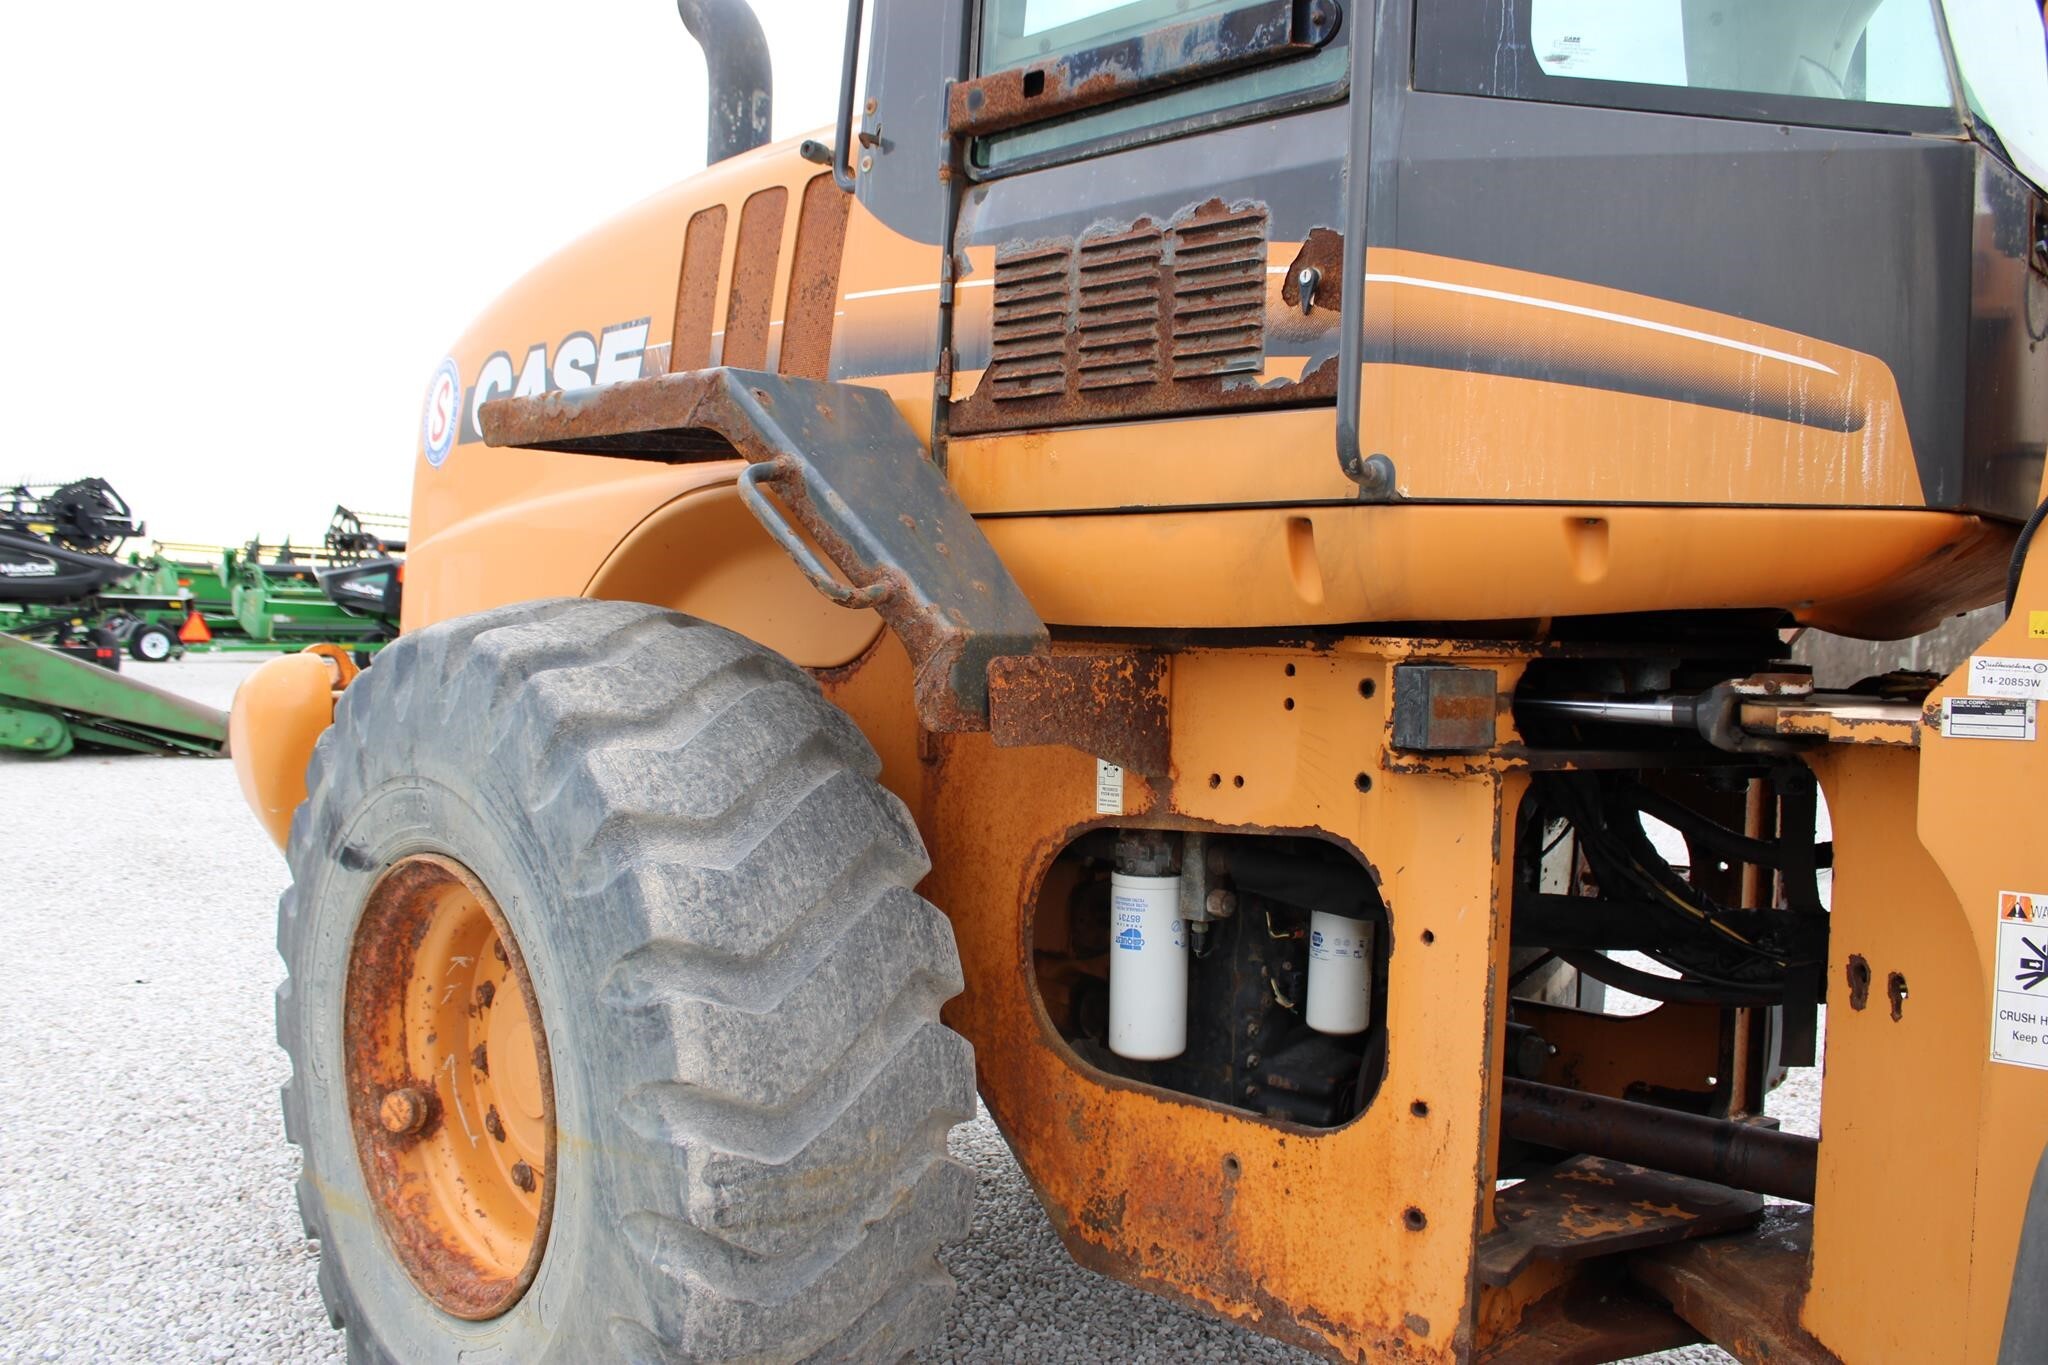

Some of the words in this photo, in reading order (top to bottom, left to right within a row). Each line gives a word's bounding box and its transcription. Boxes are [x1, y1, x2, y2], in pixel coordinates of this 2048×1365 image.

[471, 323, 650, 437] CASE
[1982, 676, 2041, 687] 14-20853W
[1119, 914, 1141, 923] 85731
[1999, 1009, 2036, 1024] CRUSH
[2012, 1030, 2038, 1045] Keep
